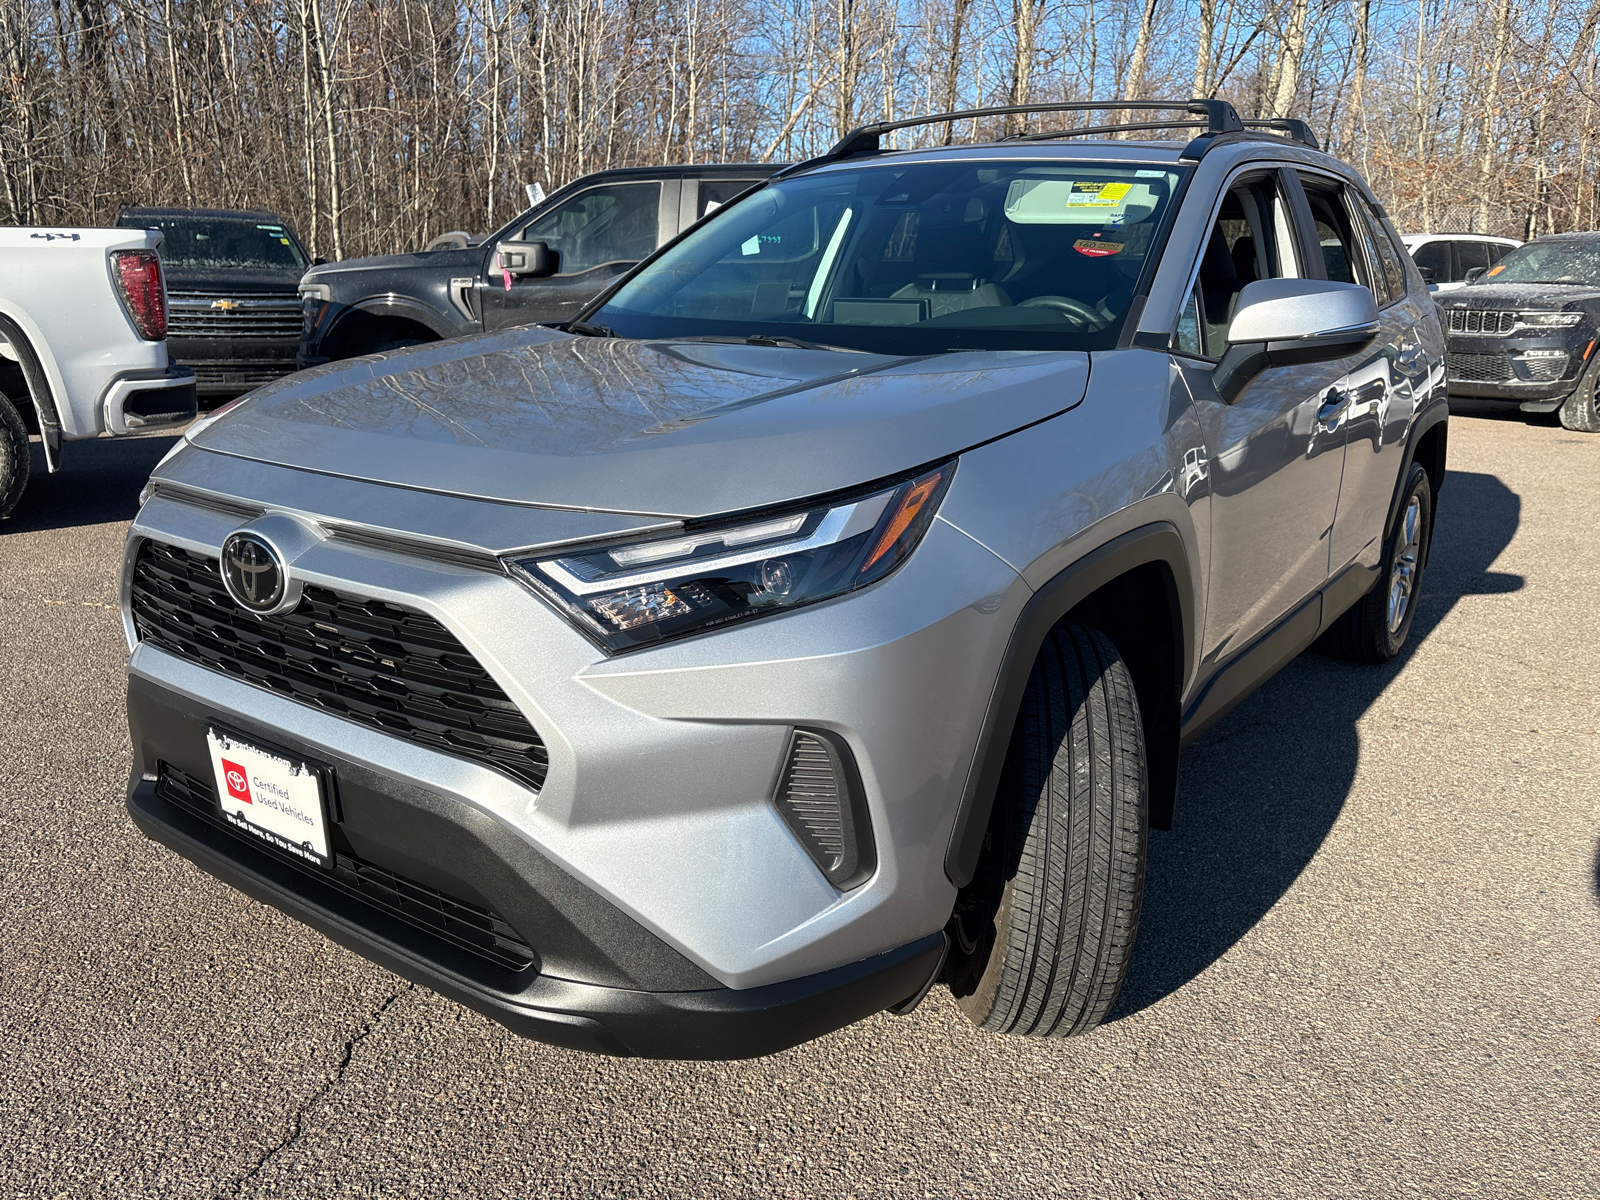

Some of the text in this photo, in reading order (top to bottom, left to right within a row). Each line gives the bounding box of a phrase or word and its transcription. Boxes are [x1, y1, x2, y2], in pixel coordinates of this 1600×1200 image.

[253, 776, 290, 800] Certified
[256, 791, 314, 827] Used Vehicles
[227, 813, 321, 866] We Sell More, So You Save More
